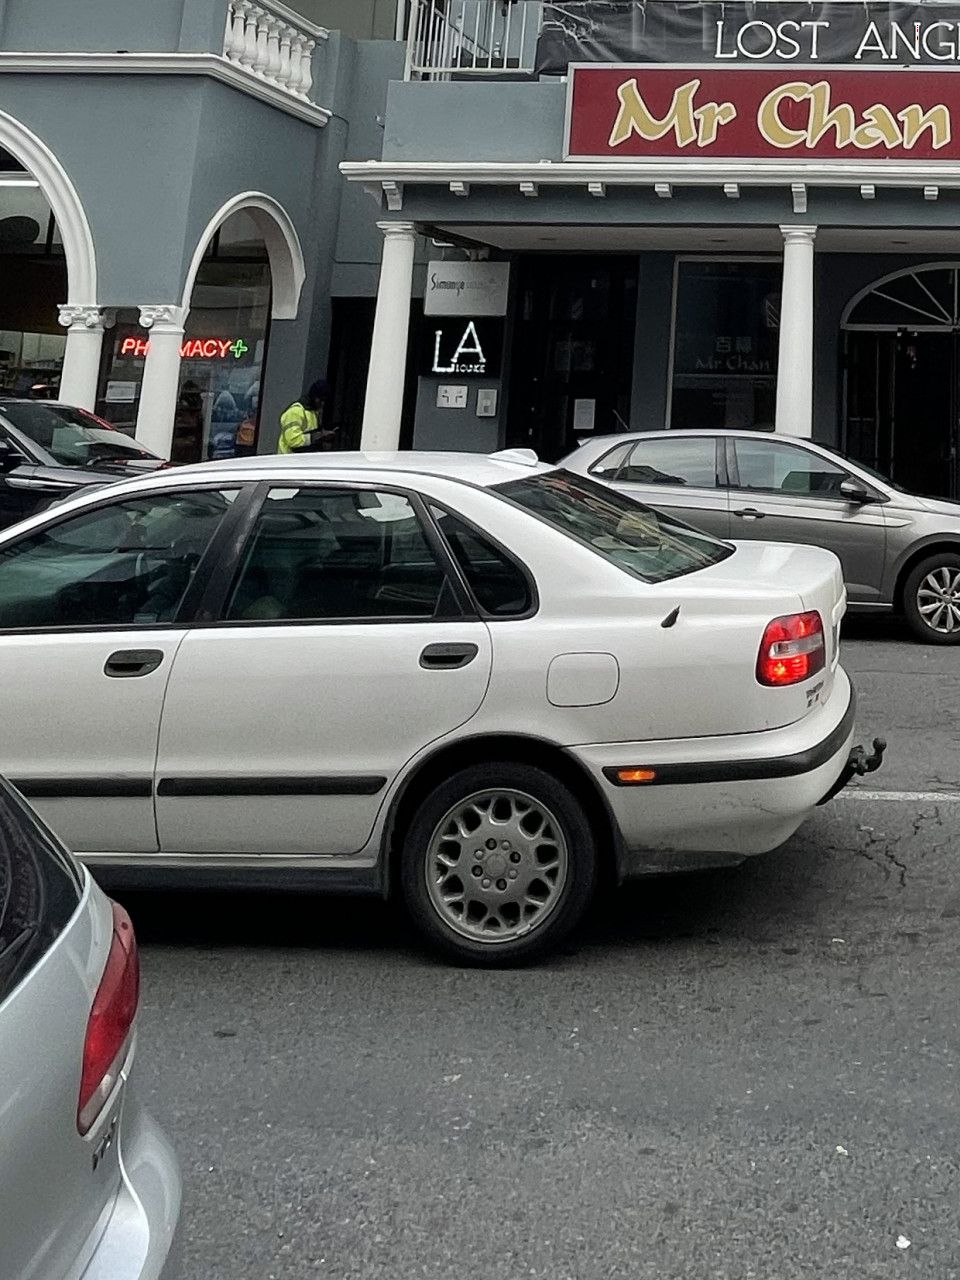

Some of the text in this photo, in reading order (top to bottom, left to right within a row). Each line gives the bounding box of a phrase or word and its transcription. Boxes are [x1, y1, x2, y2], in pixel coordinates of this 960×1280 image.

[714, 20, 831, 60] LOST
[608, 78, 952, 151] Mr Chan
[121, 338, 232, 358] PHMACY
[432, 321, 487, 372] LA
